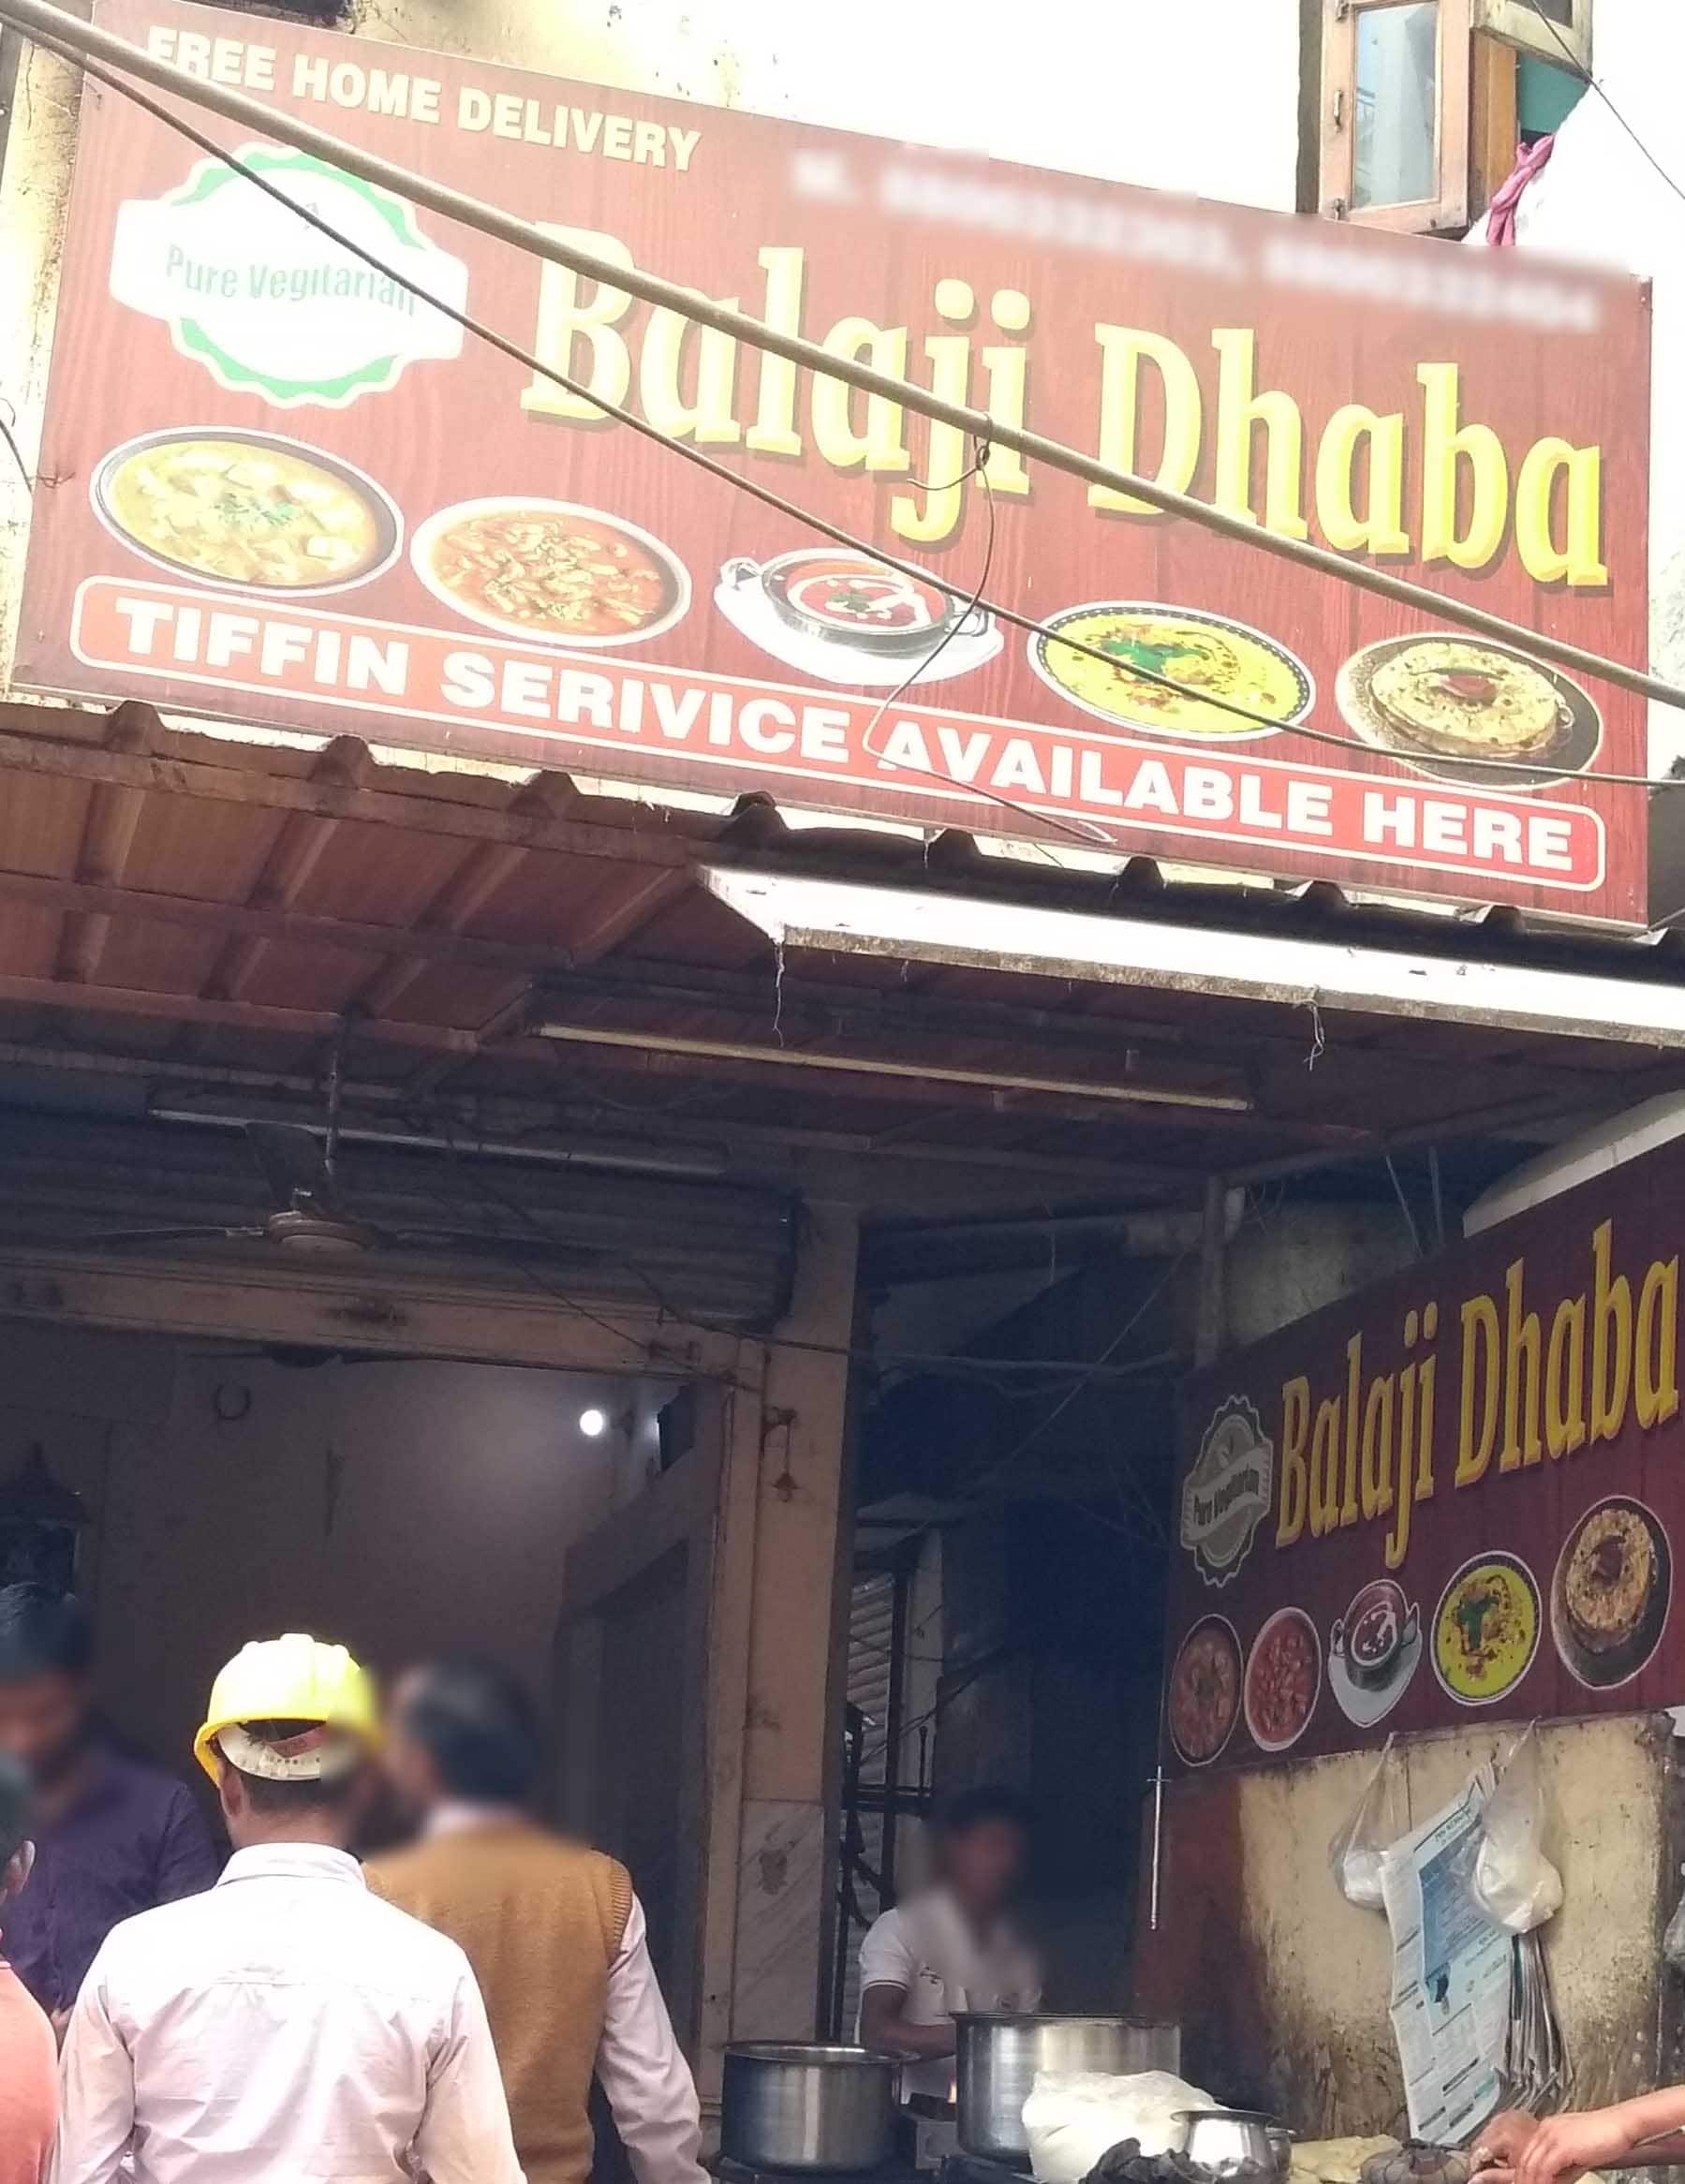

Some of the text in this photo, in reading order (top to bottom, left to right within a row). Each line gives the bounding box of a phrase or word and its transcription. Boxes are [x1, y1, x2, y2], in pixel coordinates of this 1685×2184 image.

[147, 25, 702, 172] FREE HOME DELIVERY
[166, 243, 418, 317] Pure Vegitarian
[521, 220, 1032, 544] Balaji
[1086, 322, 1610, 588] Dhaba
[115, 597, 1574, 871] TIFFIN SERIVICE AVAILABLE HERE
[1275, 1217, 1681, 1570] Balaji Dhaba
